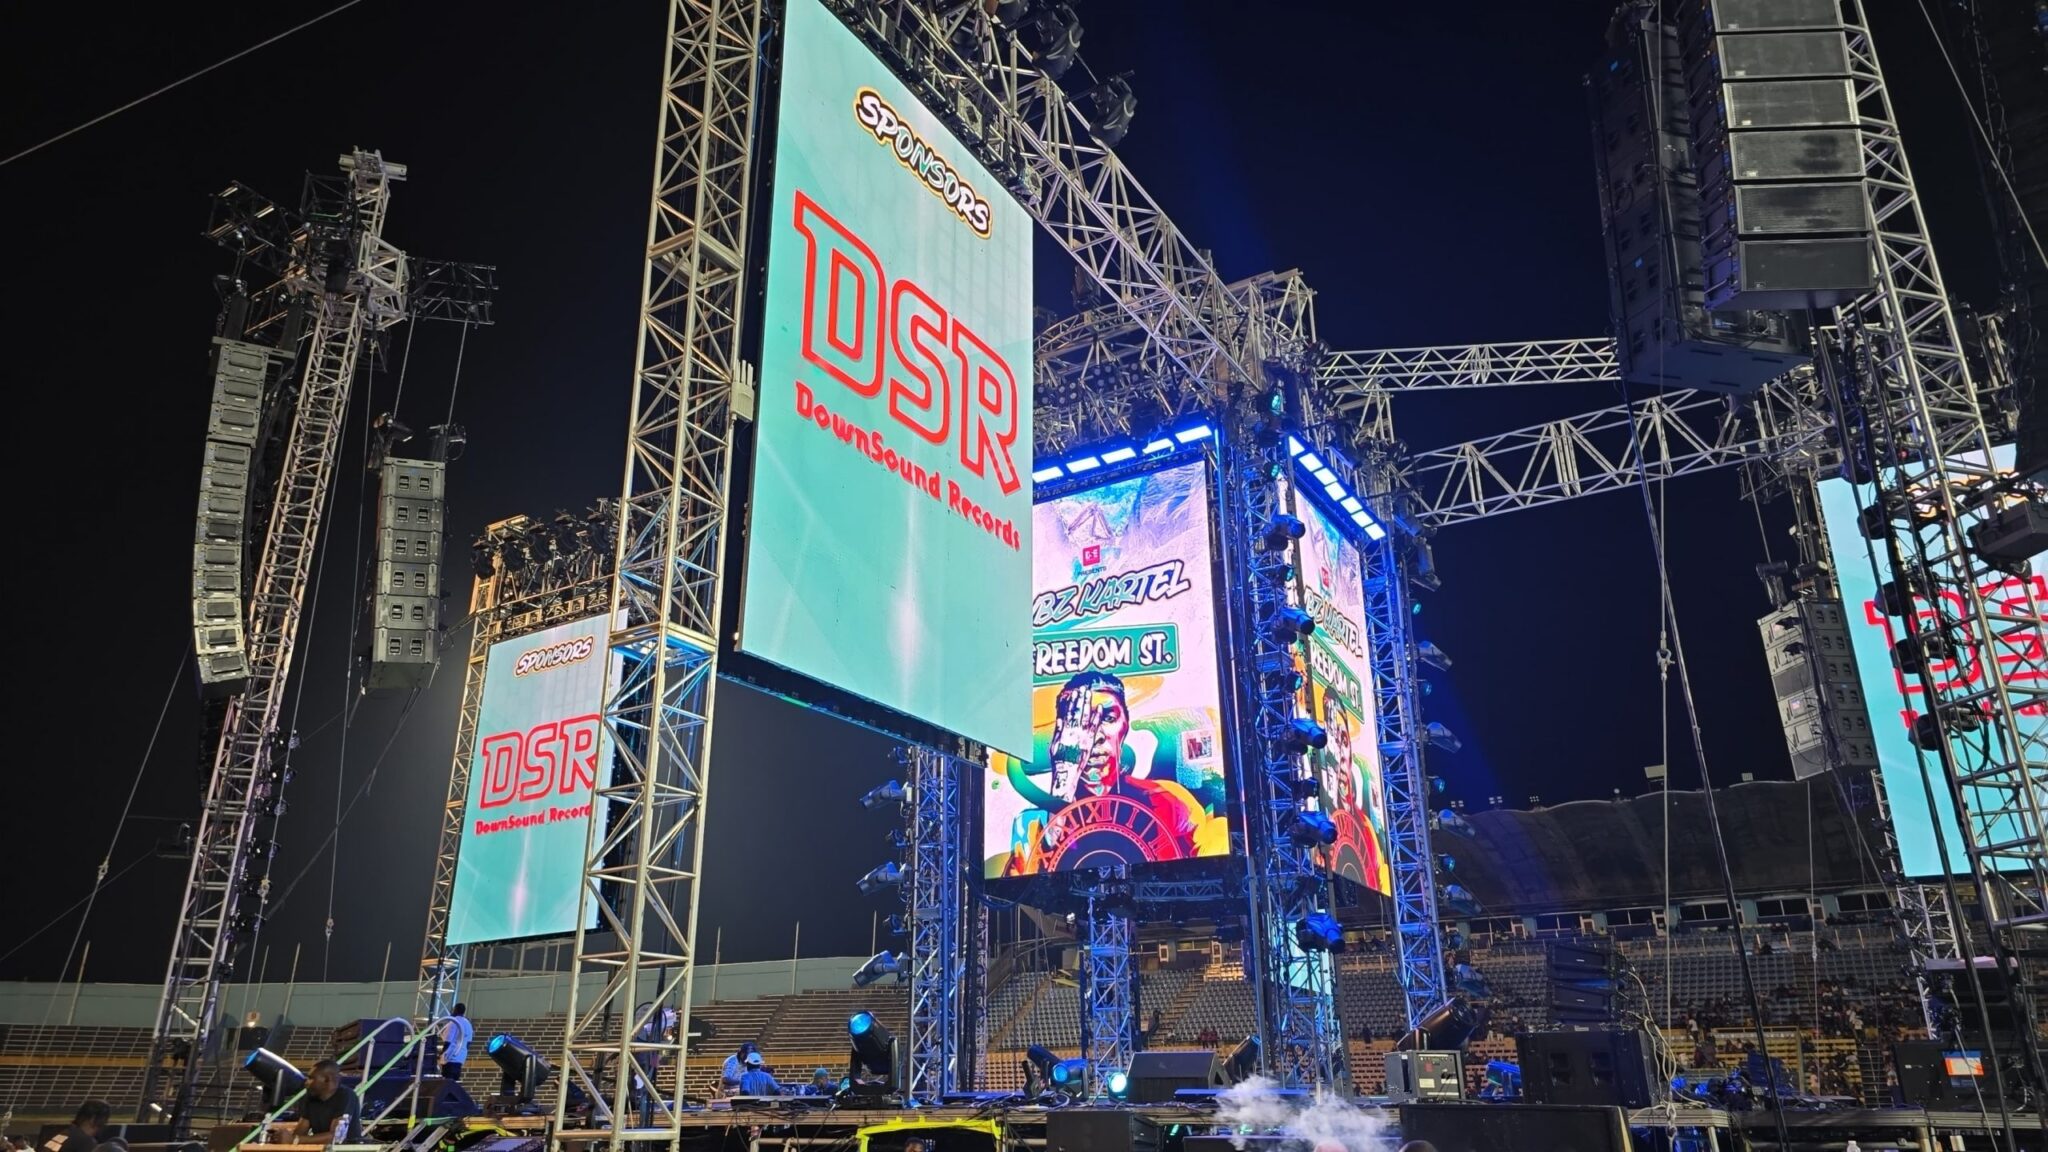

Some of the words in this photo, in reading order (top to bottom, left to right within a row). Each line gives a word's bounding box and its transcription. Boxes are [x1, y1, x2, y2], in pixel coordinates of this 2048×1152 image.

[855, 89, 991, 235] SPONSORS
[793, 189, 1021, 497] DSR
[795, 380, 942, 502] DownSound
[947, 479, 1021, 551] Records
[1075, 559, 1192, 616] KARTEL
[515, 636, 594, 676] SPONSORS
[1139, 632, 1174, 667] ST.
[480, 714, 601, 810] DSR
[475, 811, 546, 836] DownSound
[549, 804, 592, 823] Record
